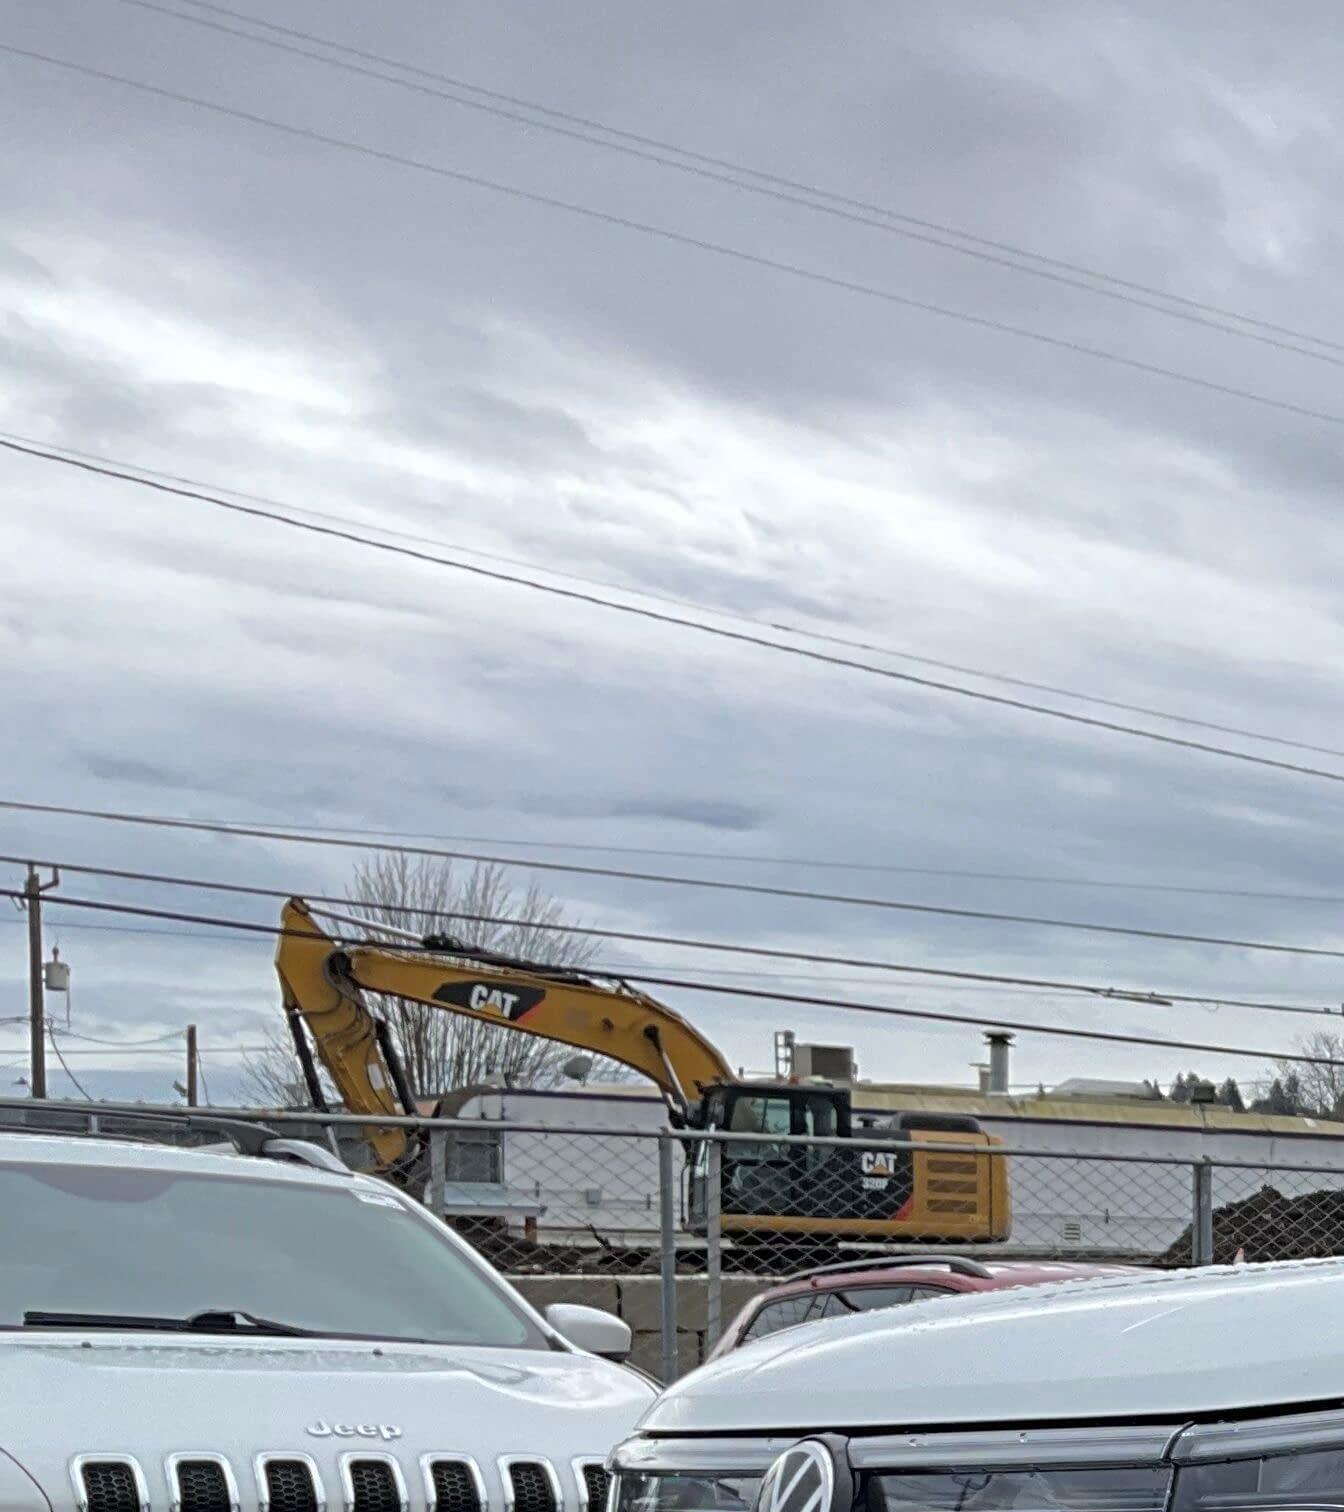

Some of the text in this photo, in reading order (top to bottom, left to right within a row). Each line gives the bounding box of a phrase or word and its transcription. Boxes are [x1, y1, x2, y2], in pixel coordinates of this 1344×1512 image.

[470, 984, 520, 1018] CAT
[861, 1151, 898, 1174] CAT
[305, 1418, 403, 1440] Jeep
